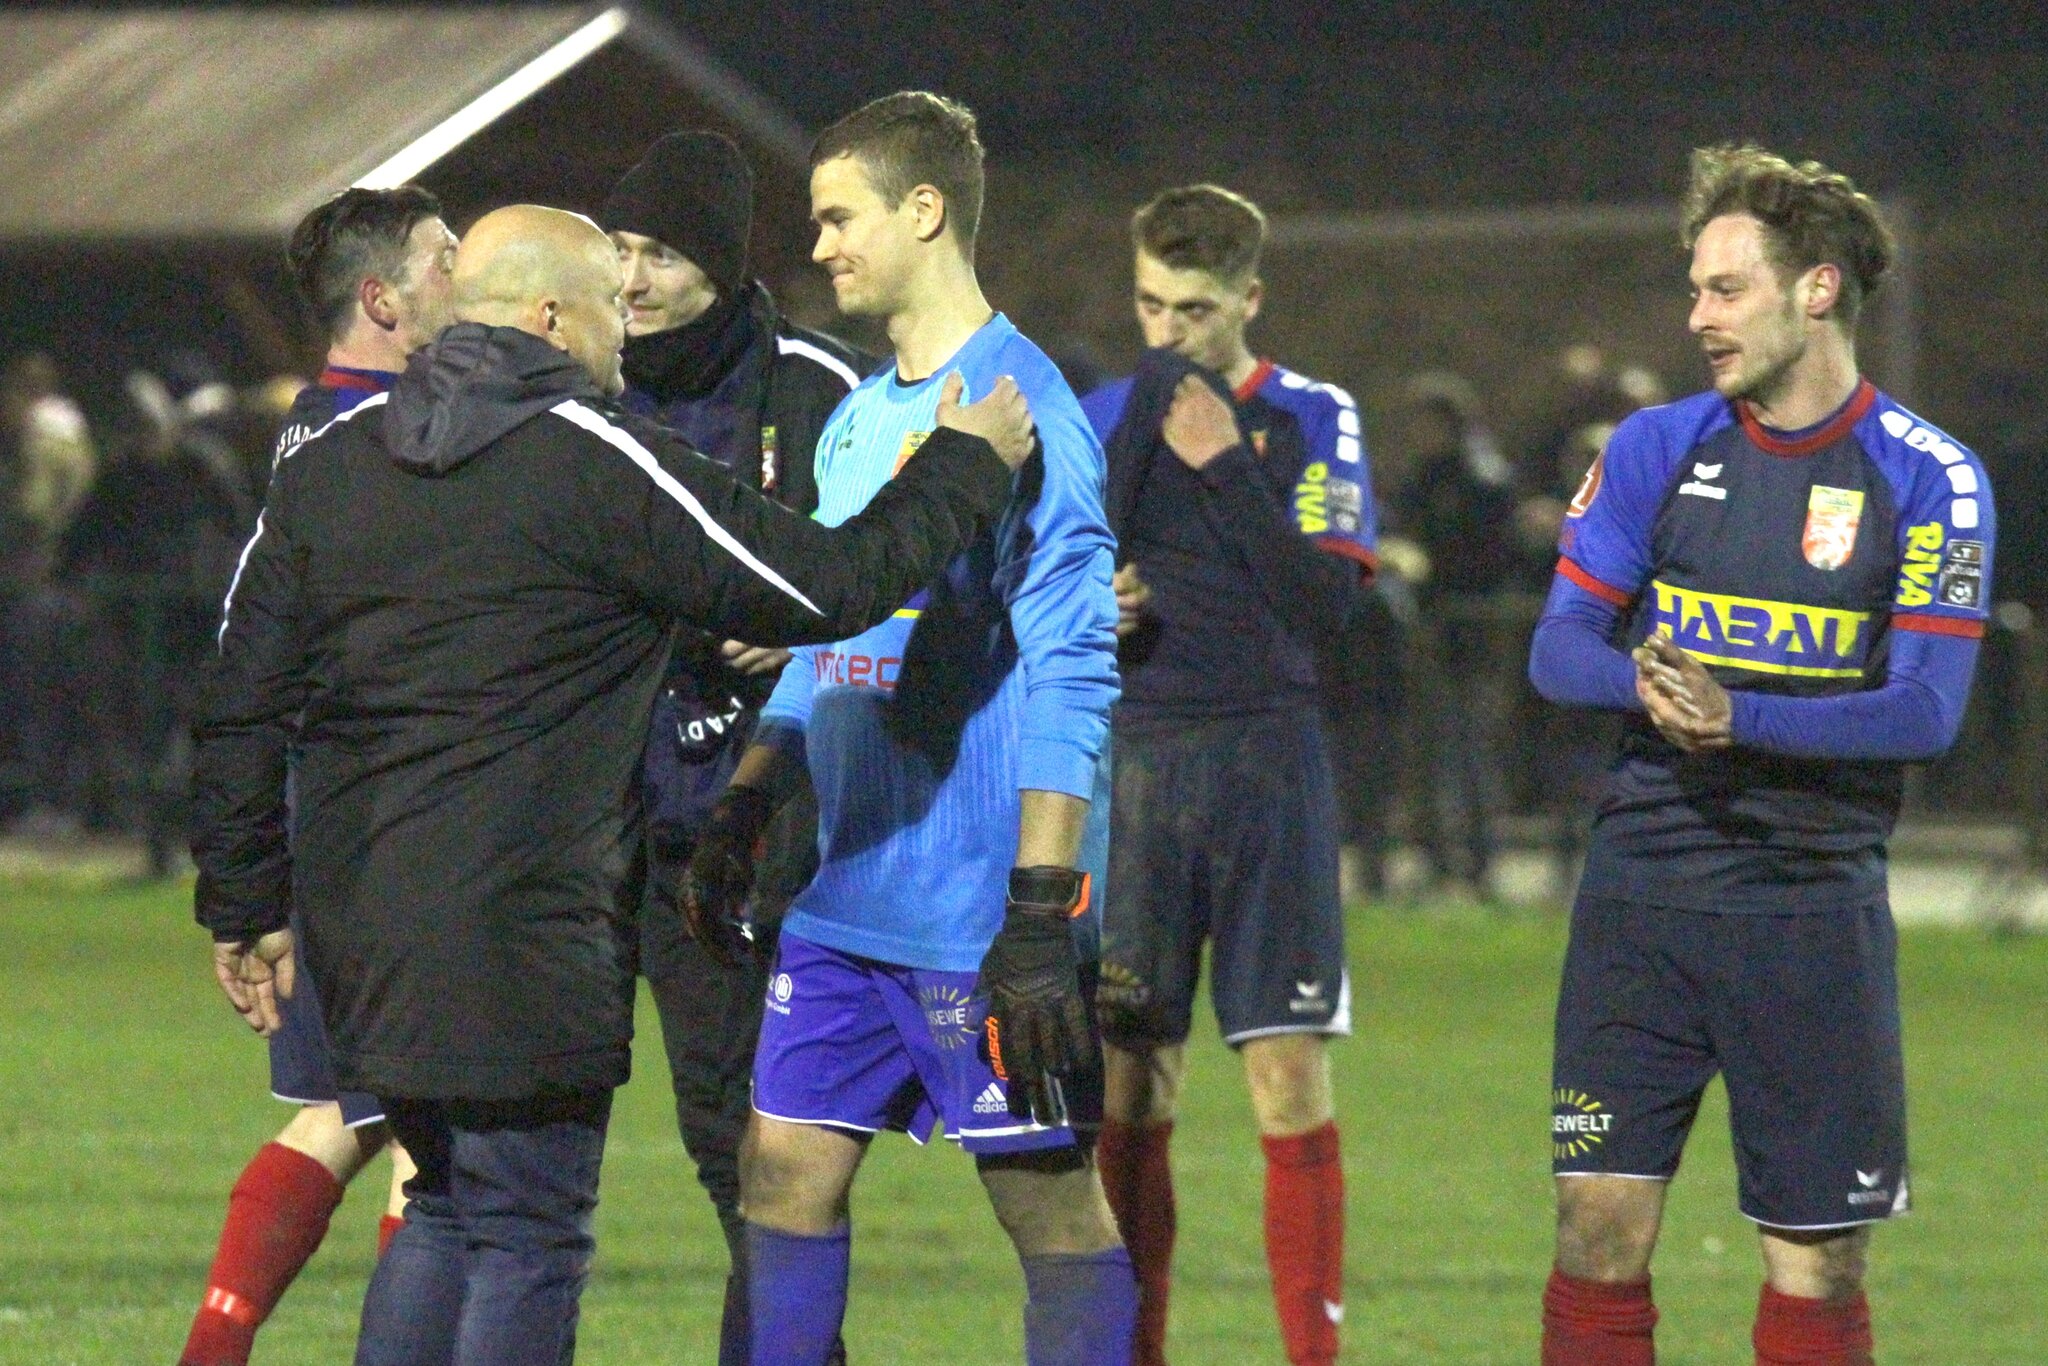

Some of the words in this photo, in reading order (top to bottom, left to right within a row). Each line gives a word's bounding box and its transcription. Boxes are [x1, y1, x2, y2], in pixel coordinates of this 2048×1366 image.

[1896, 522, 1944, 606] RIVA
[1648, 590, 1874, 670] HABAU
[973, 1102, 1008, 1113] adida
